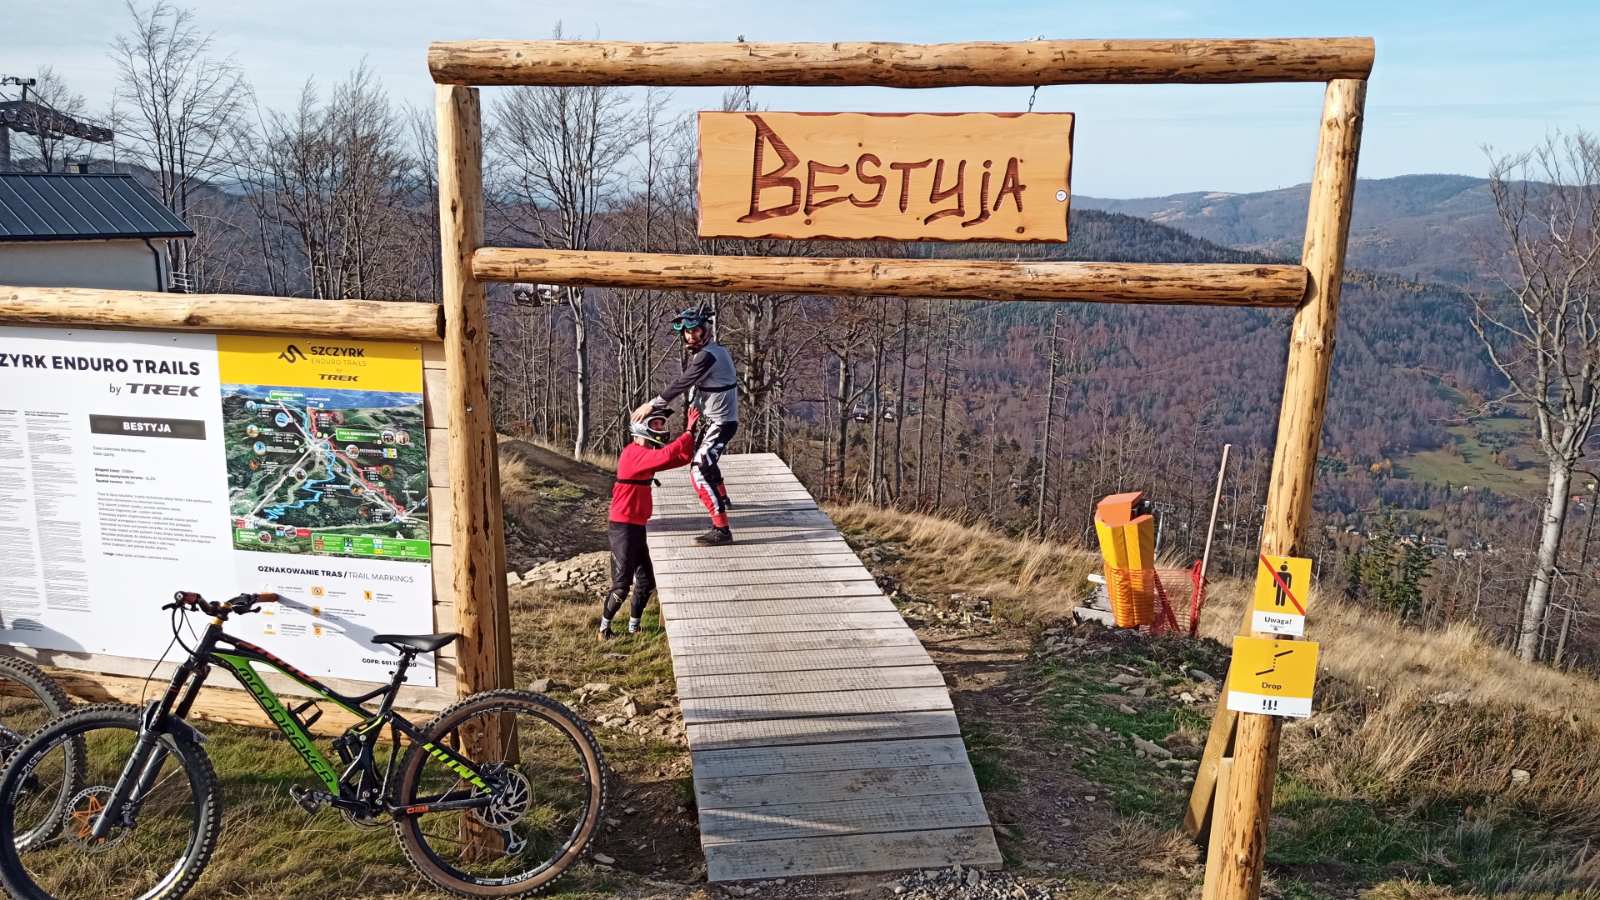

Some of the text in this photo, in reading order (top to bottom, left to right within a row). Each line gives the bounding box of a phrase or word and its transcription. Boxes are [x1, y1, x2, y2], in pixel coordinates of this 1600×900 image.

[310, 346, 365, 357] SZCZYRK
[0, 353, 200, 376] ZYRK ENDURO TRAILS
[319, 373, 359, 382] TREK
[109, 383, 201, 397] by TREK
[122, 420, 172, 433] BESTYJA
[257, 565, 319, 576] OZNAKOWANIE
[321, 570, 343, 578] TRAS
[349, 571, 369, 580] TRAIL
[371, 573, 414, 583] MARKINGS
[1264, 616, 1293, 625] Uwaga!
[1261, 681, 1282, 690] Drop
